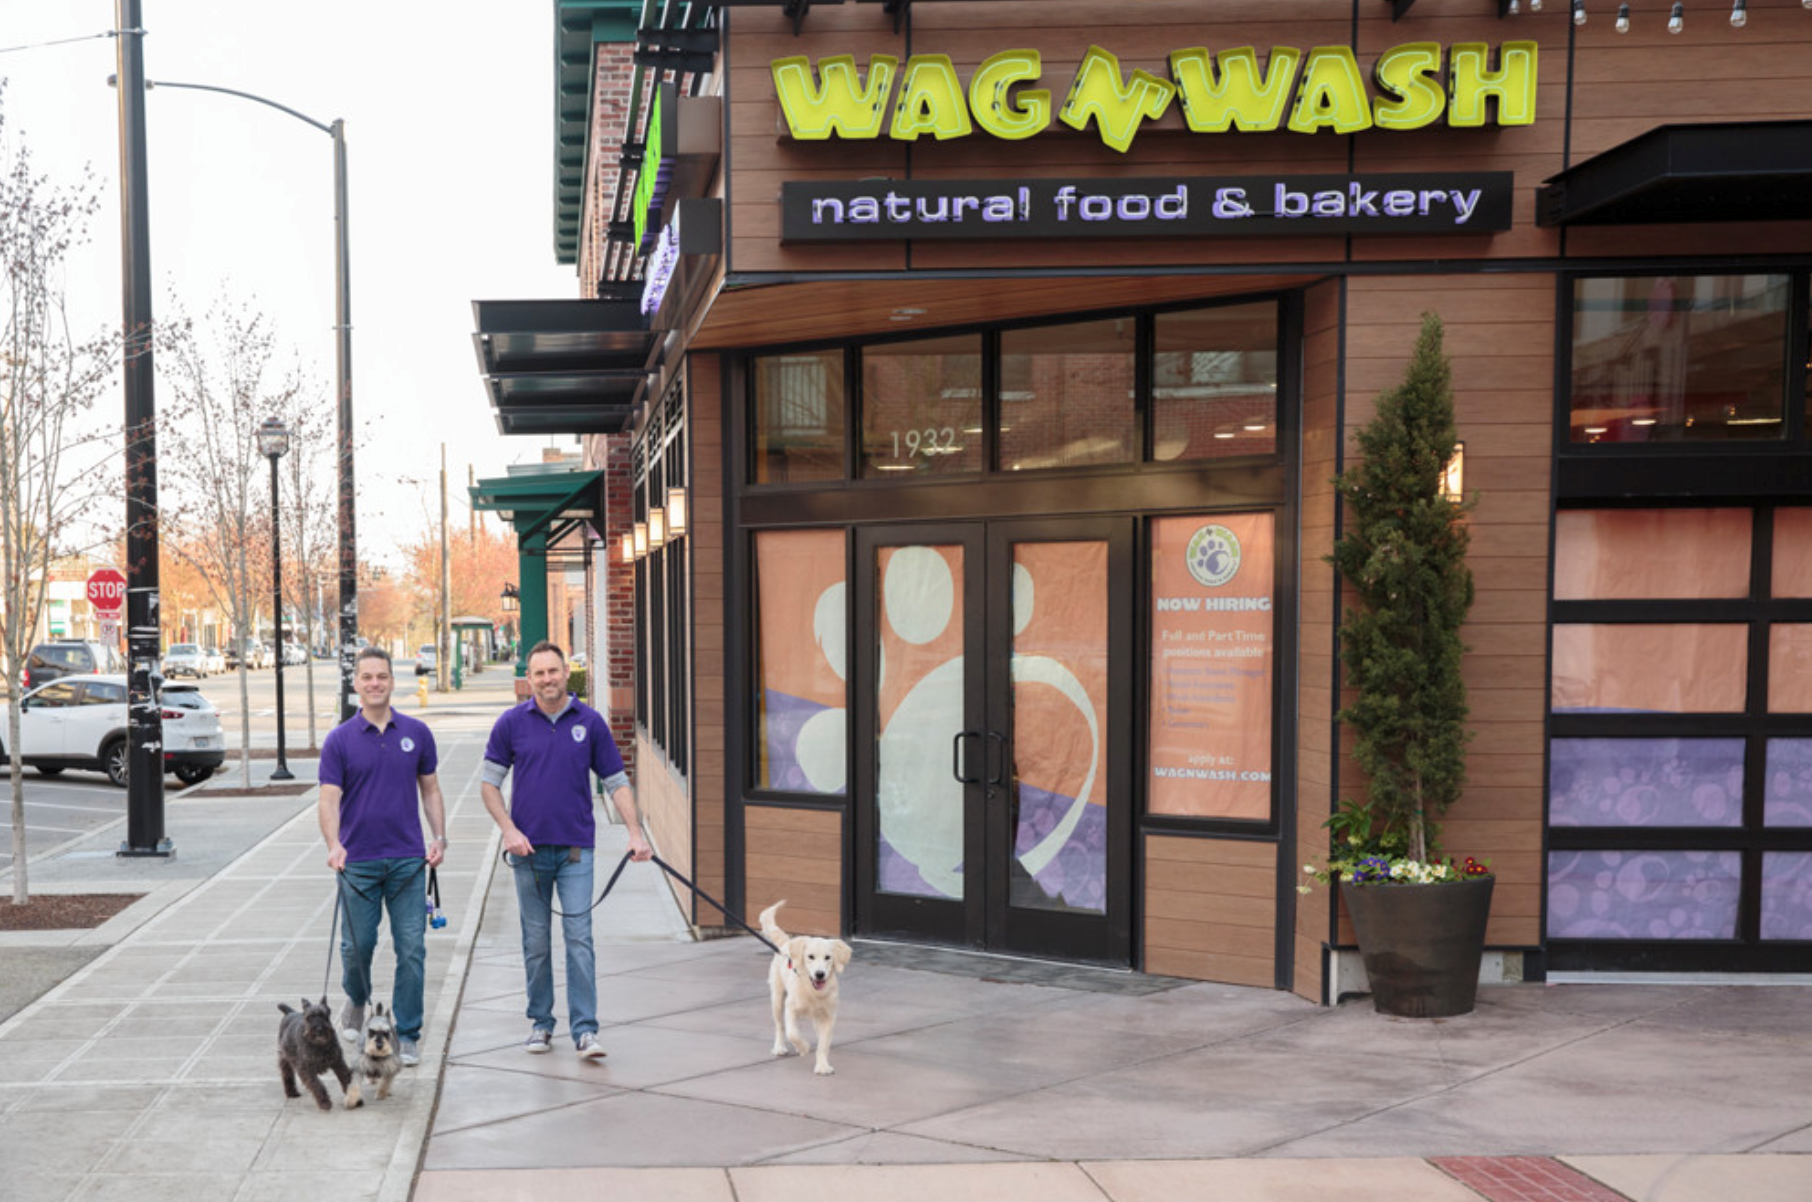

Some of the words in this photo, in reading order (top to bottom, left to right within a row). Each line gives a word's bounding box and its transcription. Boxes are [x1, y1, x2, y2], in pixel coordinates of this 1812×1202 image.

[771, 48, 1051, 141] WAG
[1170, 40, 1538, 135] WASH
[812, 186, 1031, 224] natural
[1054, 184, 1188, 222] food
[1212, 187, 1255, 219] &
[1274, 182, 1482, 224] bakery
[889, 427, 955, 459] 1932
[88, 581, 125, 599] STOP
[1157, 597, 1201, 612] NOW
[1205, 596, 1272, 612] HIRING
[1208, 629, 1233, 641] Part
[1154, 767, 1272, 782] WAGNWASH.COM
